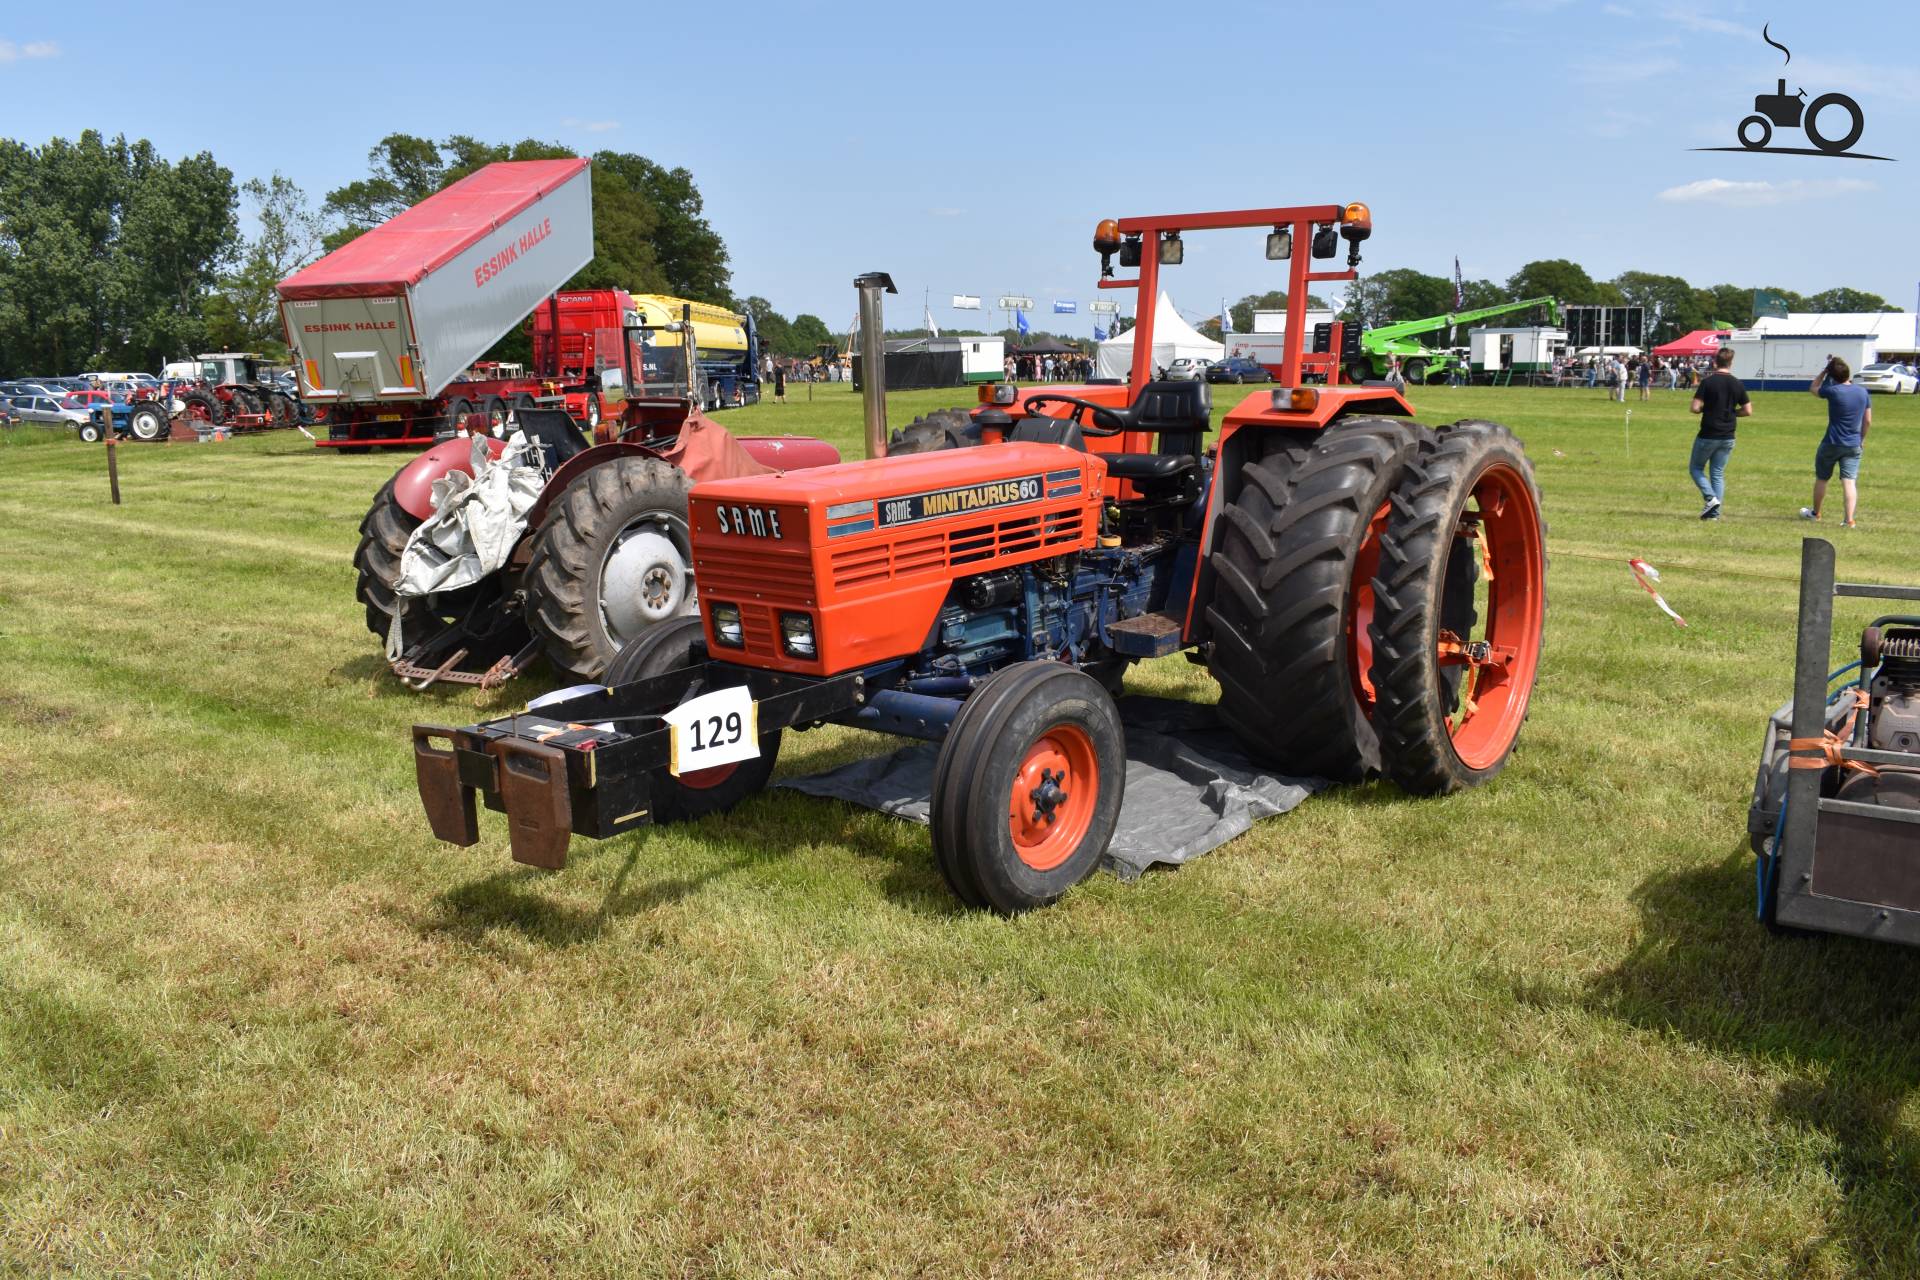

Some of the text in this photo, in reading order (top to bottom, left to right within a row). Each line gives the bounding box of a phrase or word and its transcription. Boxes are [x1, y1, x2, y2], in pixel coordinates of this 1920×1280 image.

[474, 216, 552, 289] ESSINK HALLE
[304, 321, 396, 333] ESSINK HALLE
[716, 505, 782, 539] SAME
[885, 499, 912, 524] SAME
[690, 711, 742, 752] 129
